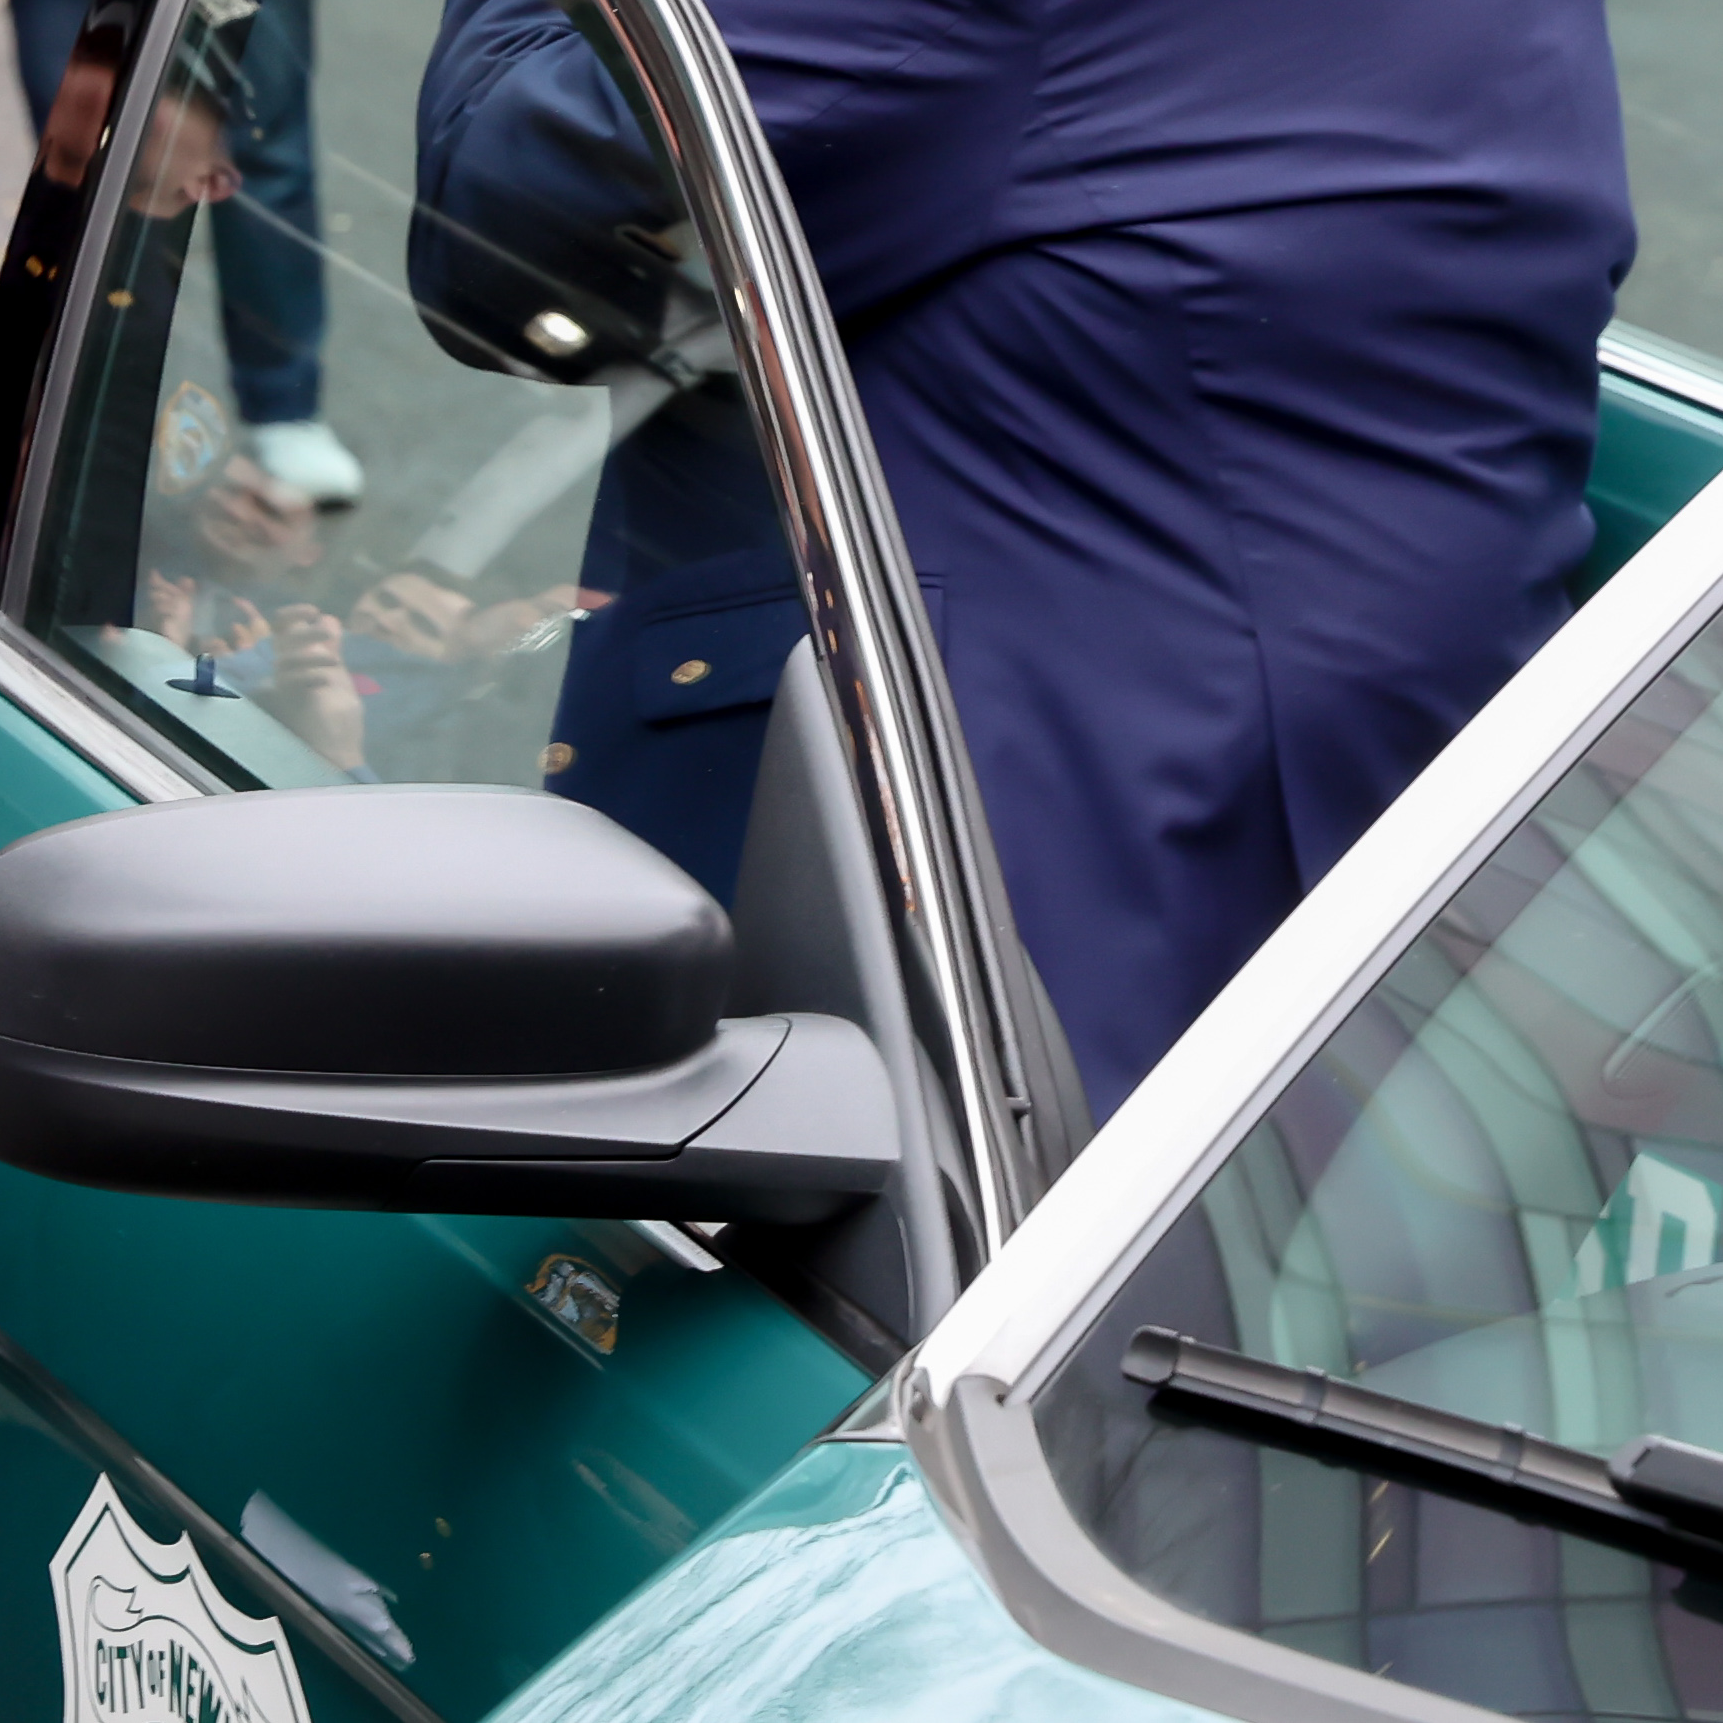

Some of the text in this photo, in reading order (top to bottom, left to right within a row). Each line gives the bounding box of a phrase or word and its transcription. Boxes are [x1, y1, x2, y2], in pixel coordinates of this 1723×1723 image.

[95, 1638, 221, 1723] CITY OF NEW
